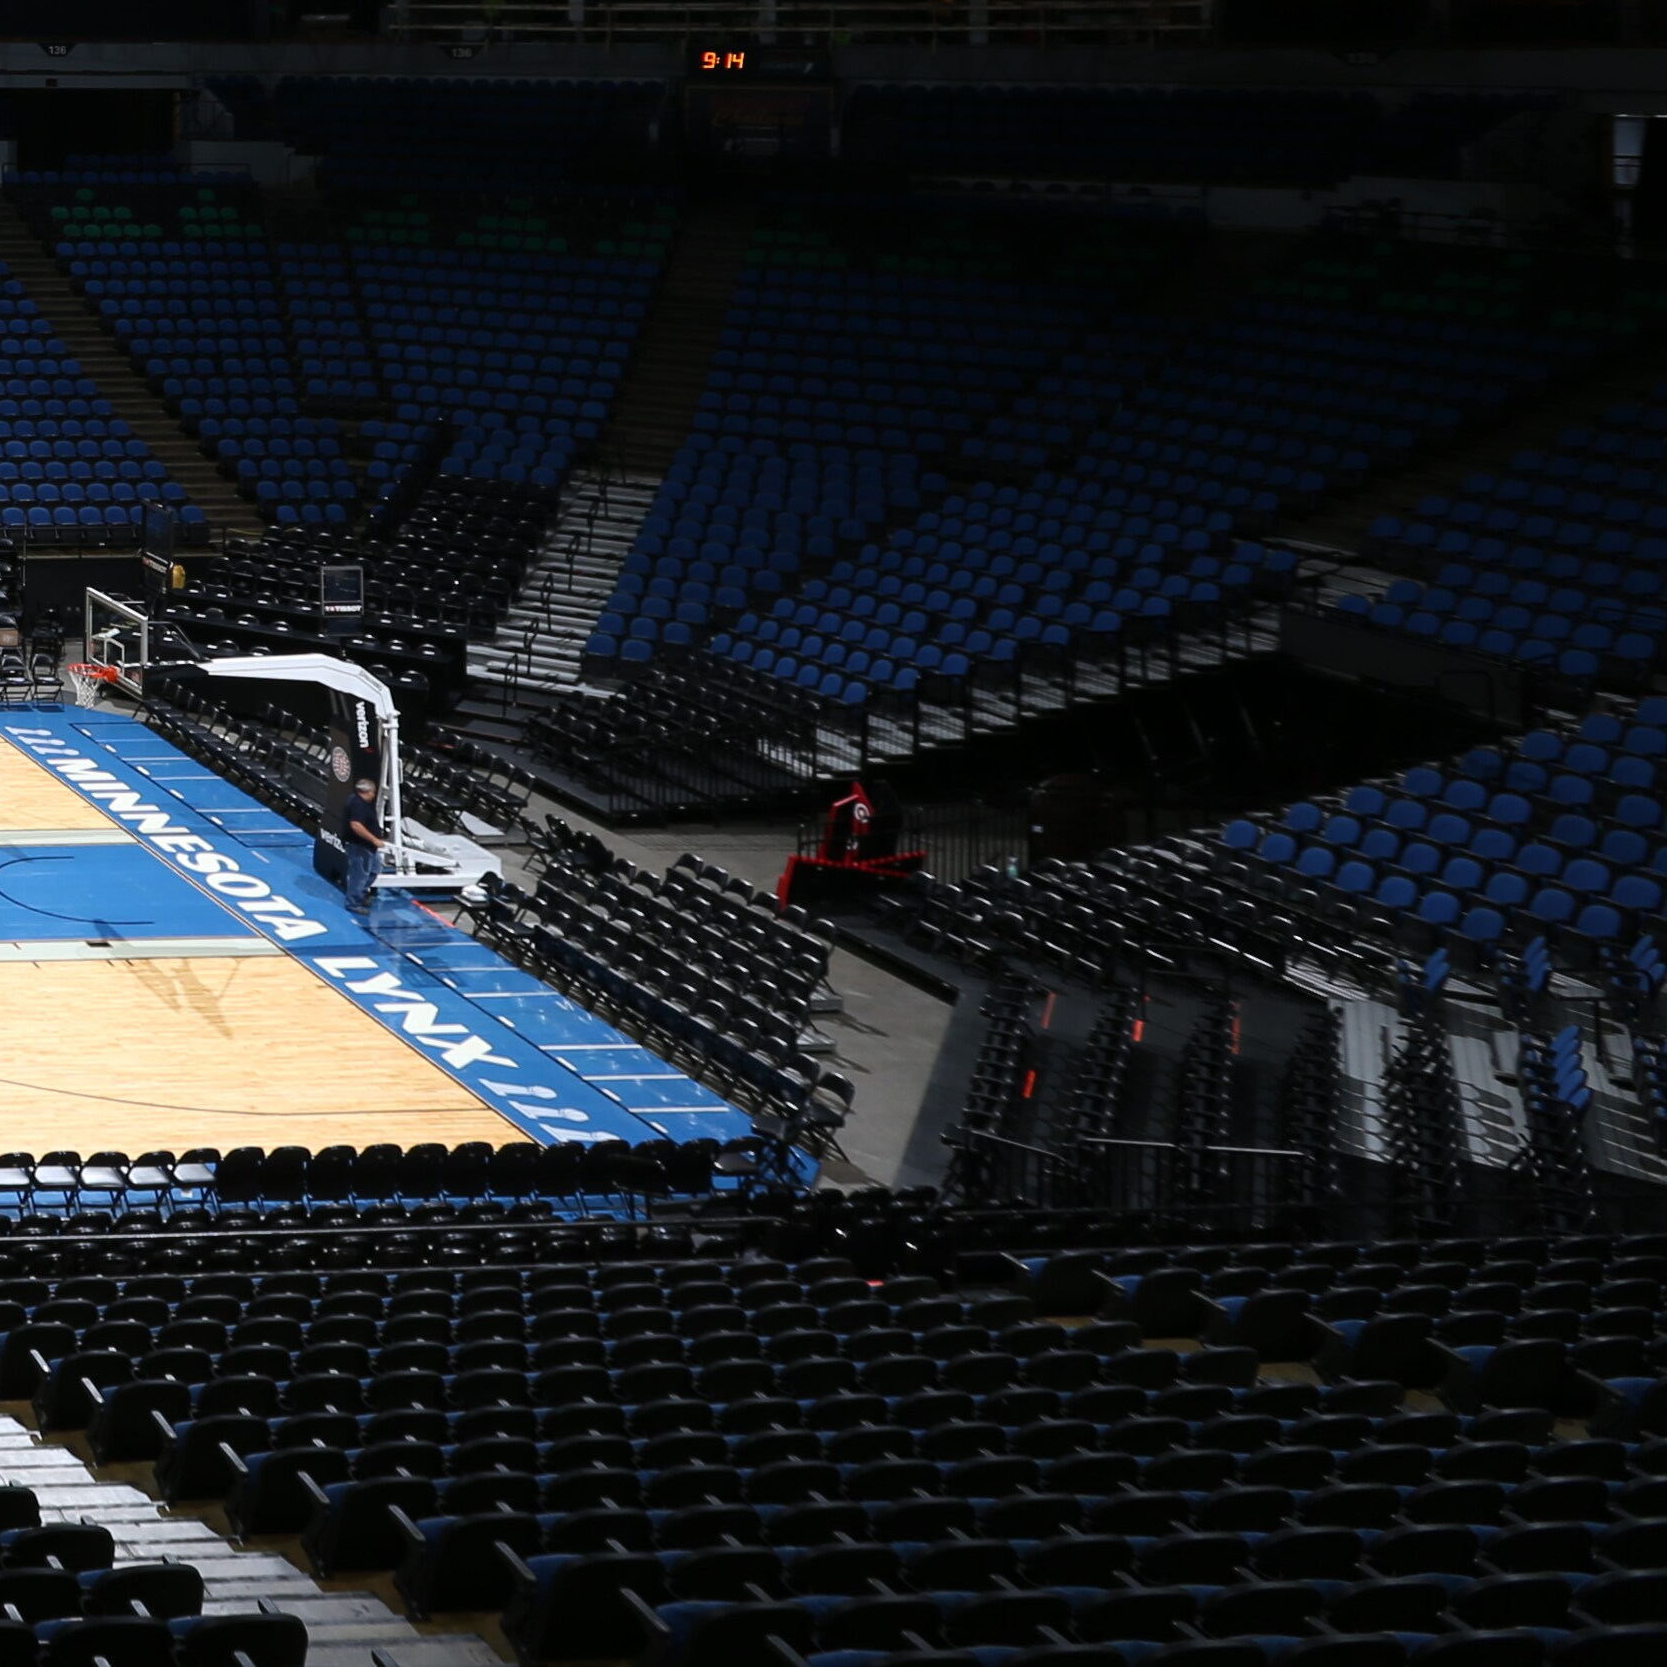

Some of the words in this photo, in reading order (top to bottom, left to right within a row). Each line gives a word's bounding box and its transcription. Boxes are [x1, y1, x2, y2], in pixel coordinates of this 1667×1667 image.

[48, 45, 67, 56] 136
[700, 50, 746, 70] 9:14
[355, 700, 370, 749] verizon
[319, 827, 347, 854] veriz
[48, 755, 329, 943] MINNESOTA
[313, 955, 520, 1070] LYNX
